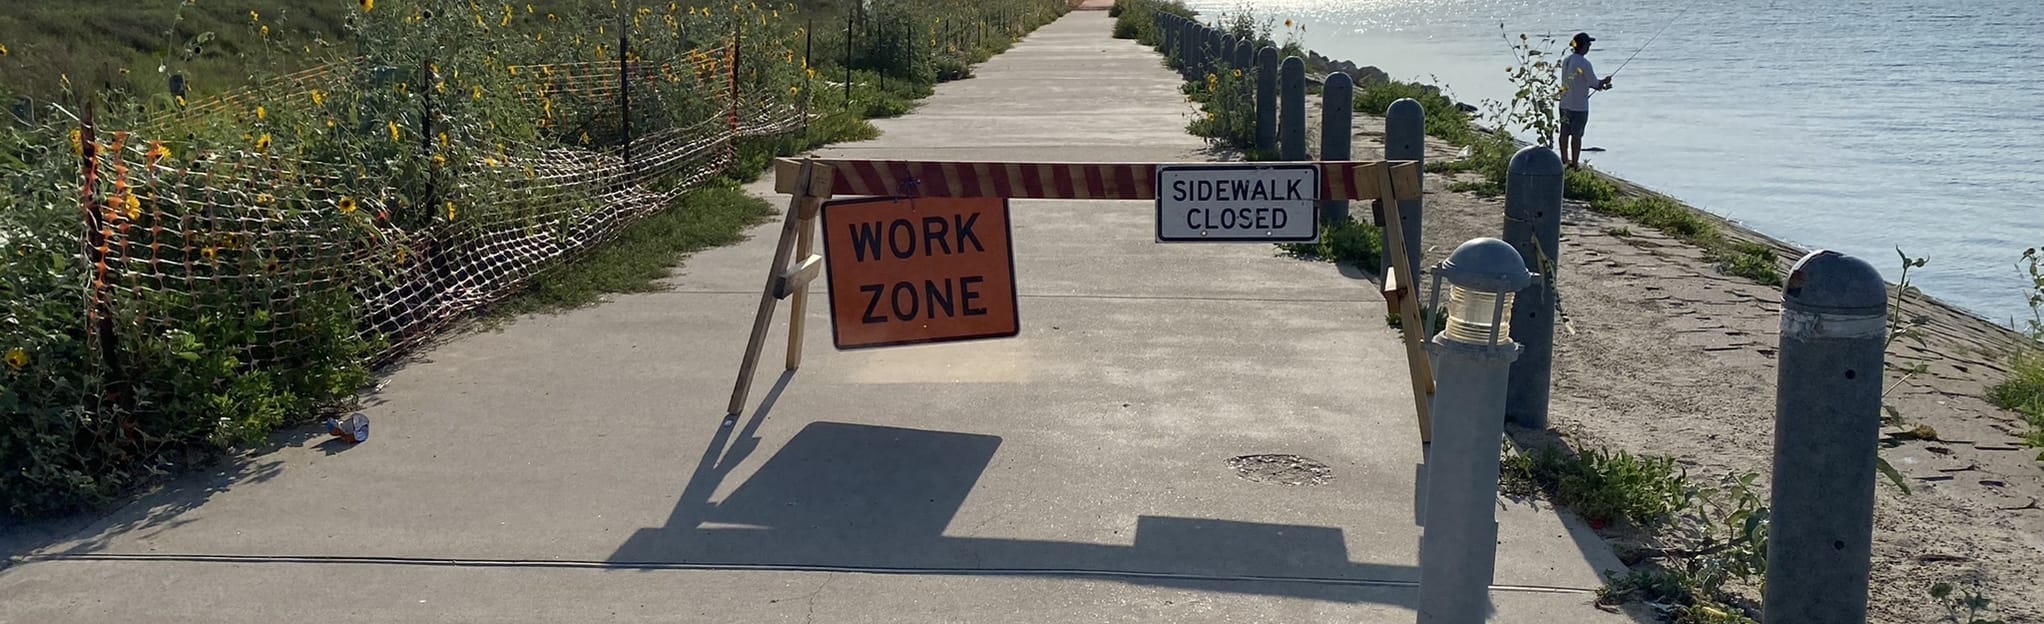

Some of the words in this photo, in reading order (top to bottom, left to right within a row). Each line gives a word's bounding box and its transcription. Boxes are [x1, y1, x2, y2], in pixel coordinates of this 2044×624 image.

[1172, 179, 1302, 201] SIDEWALK
[1187, 208, 1288, 229] CLOSED
[849, 212, 985, 262] WORK
[860, 275, 988, 324] ZONE
